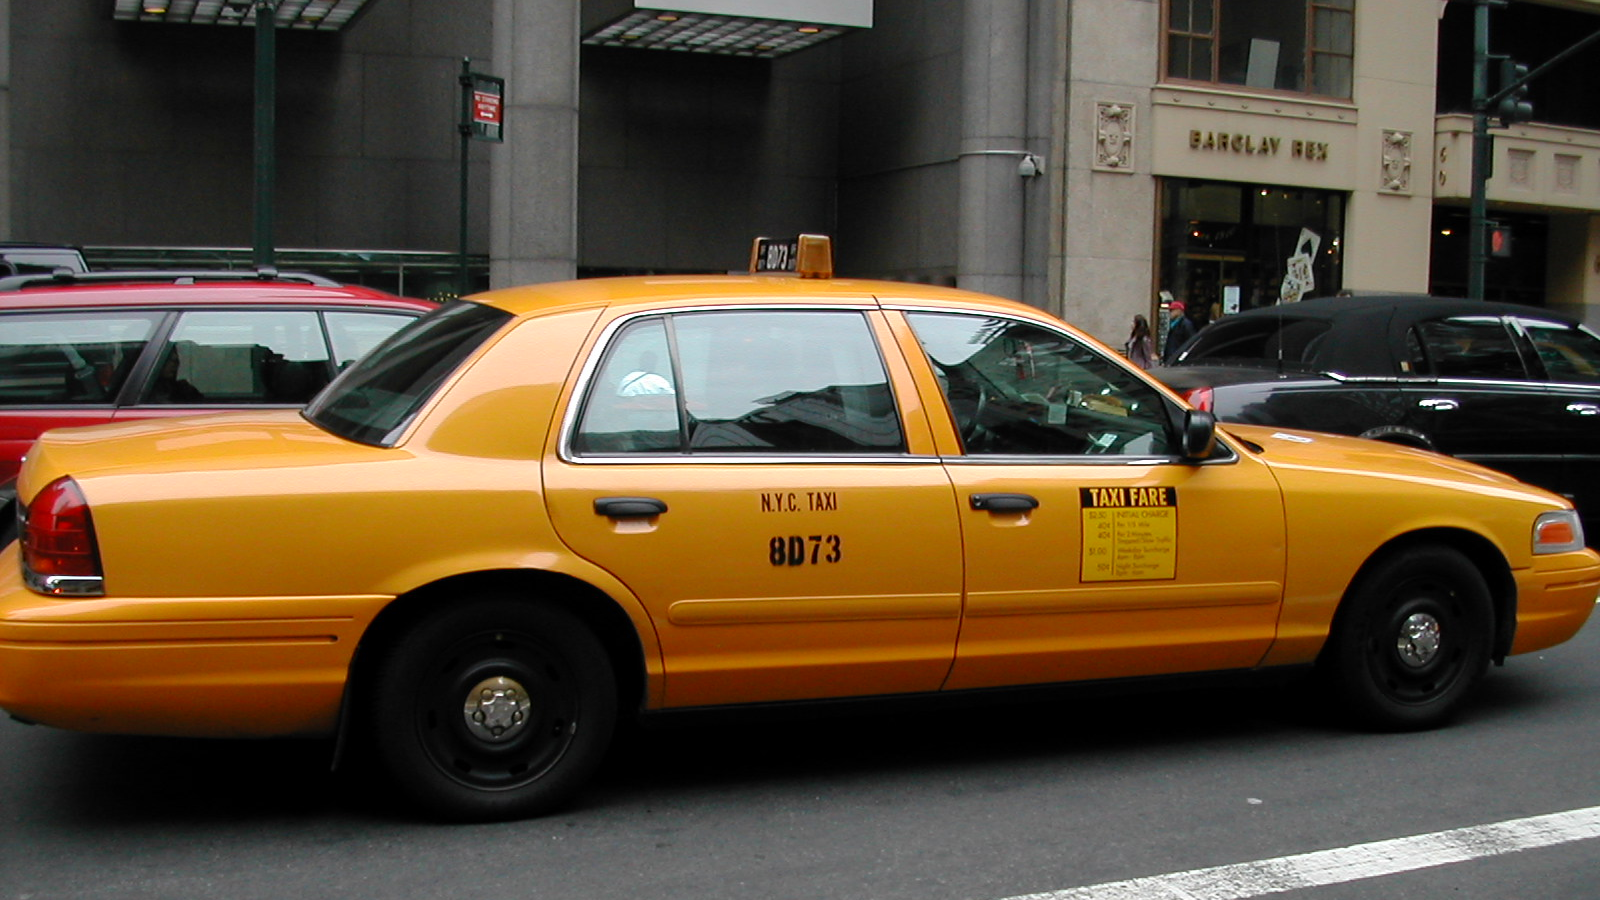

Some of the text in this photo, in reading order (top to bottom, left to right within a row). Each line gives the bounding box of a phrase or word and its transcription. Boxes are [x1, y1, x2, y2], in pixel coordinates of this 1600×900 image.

[1189, 129, 1329, 161] BARCLAY REX
[761, 491, 837, 512] N.Y.C. TAXI
[1089, 487, 1168, 507] TAXI FARE
[1116, 511, 1139, 519] INITIAL
[1141, 510, 1169, 519] CHARGE
[769, 534, 841, 567] 8D73
